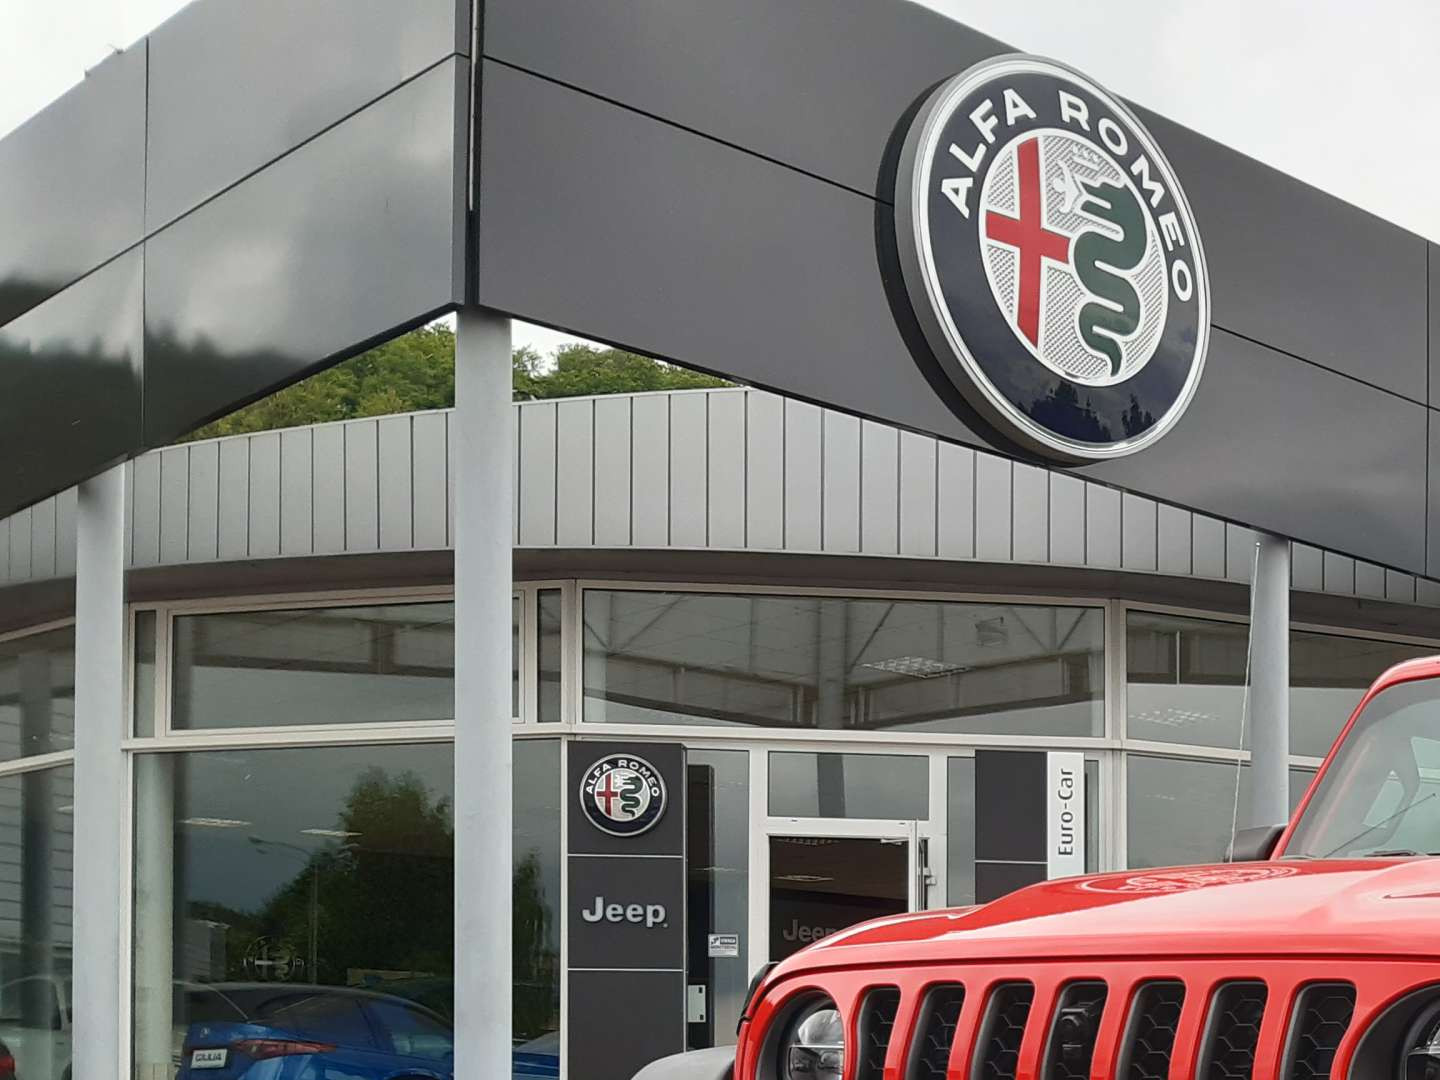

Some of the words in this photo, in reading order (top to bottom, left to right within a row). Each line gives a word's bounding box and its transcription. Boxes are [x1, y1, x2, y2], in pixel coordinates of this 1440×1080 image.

[941, 88, 1037, 219] ALFA
[1058, 90, 1193, 302] ROMEO
[585, 763, 612, 794] ALFA
[617, 759, 660, 797] ROMEO
[1057, 768, 1074, 856] Euro-Car
[582, 896, 667, 928] Jeep
